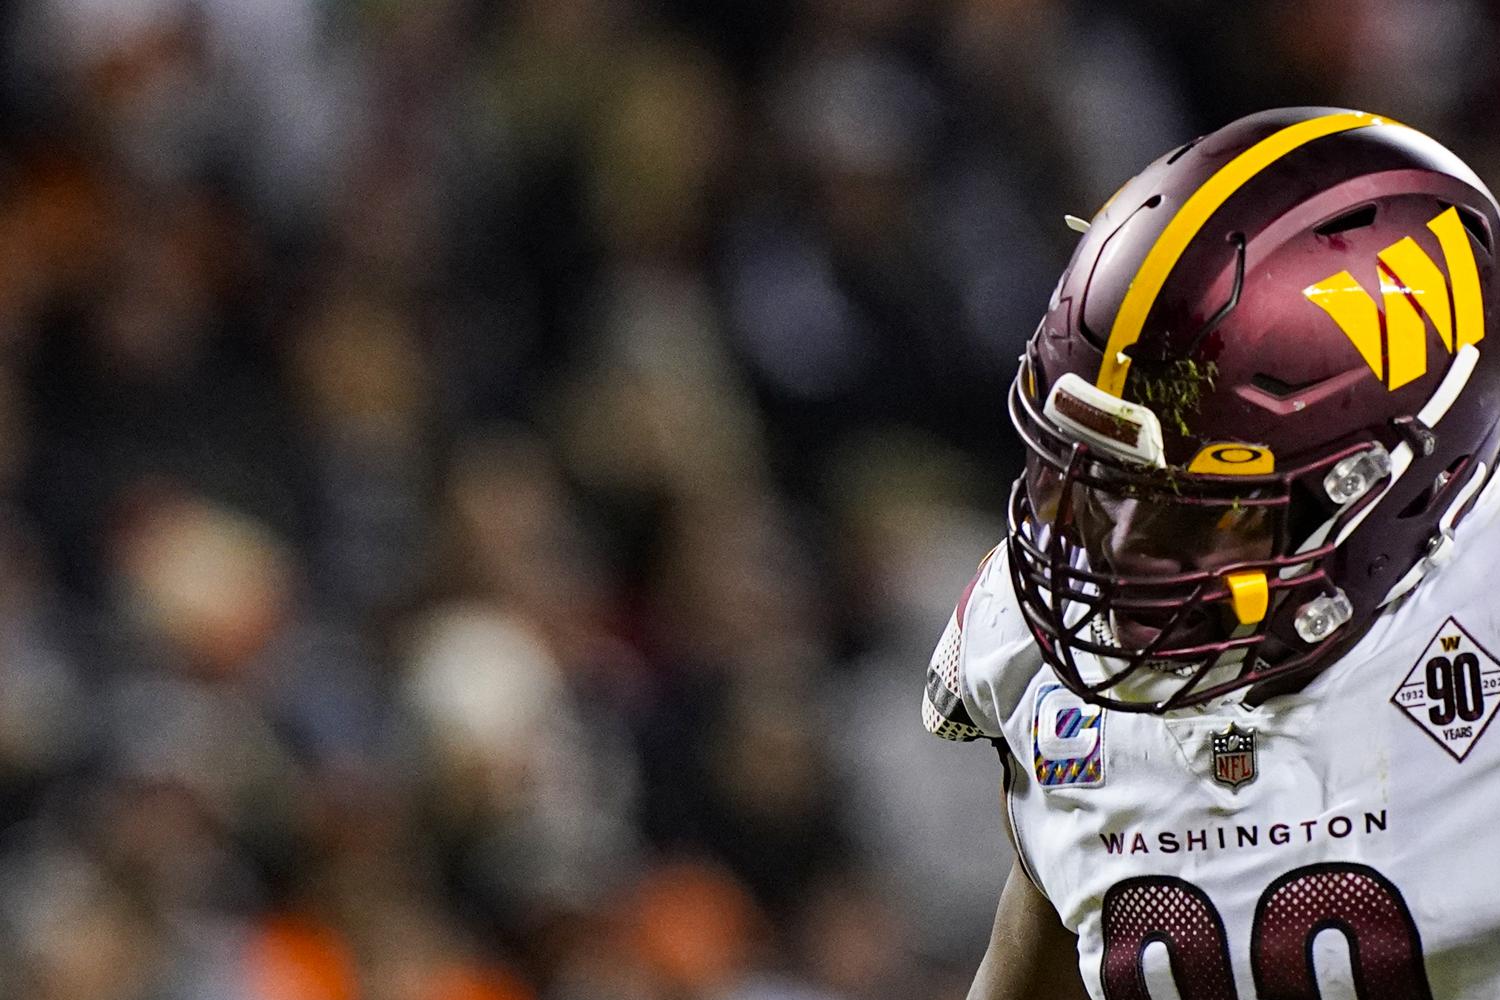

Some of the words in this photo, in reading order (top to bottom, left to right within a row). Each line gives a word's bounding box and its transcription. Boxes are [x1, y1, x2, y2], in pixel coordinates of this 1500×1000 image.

[1401, 690, 1424, 701] 1932
[1425, 652, 1485, 726] 90
[1038, 687, 1101, 760] C
[1443, 726, 1473, 740] YEARS
[1216, 753, 1252, 780] NFL
[1100, 809, 1388, 855] WASHINGTON
